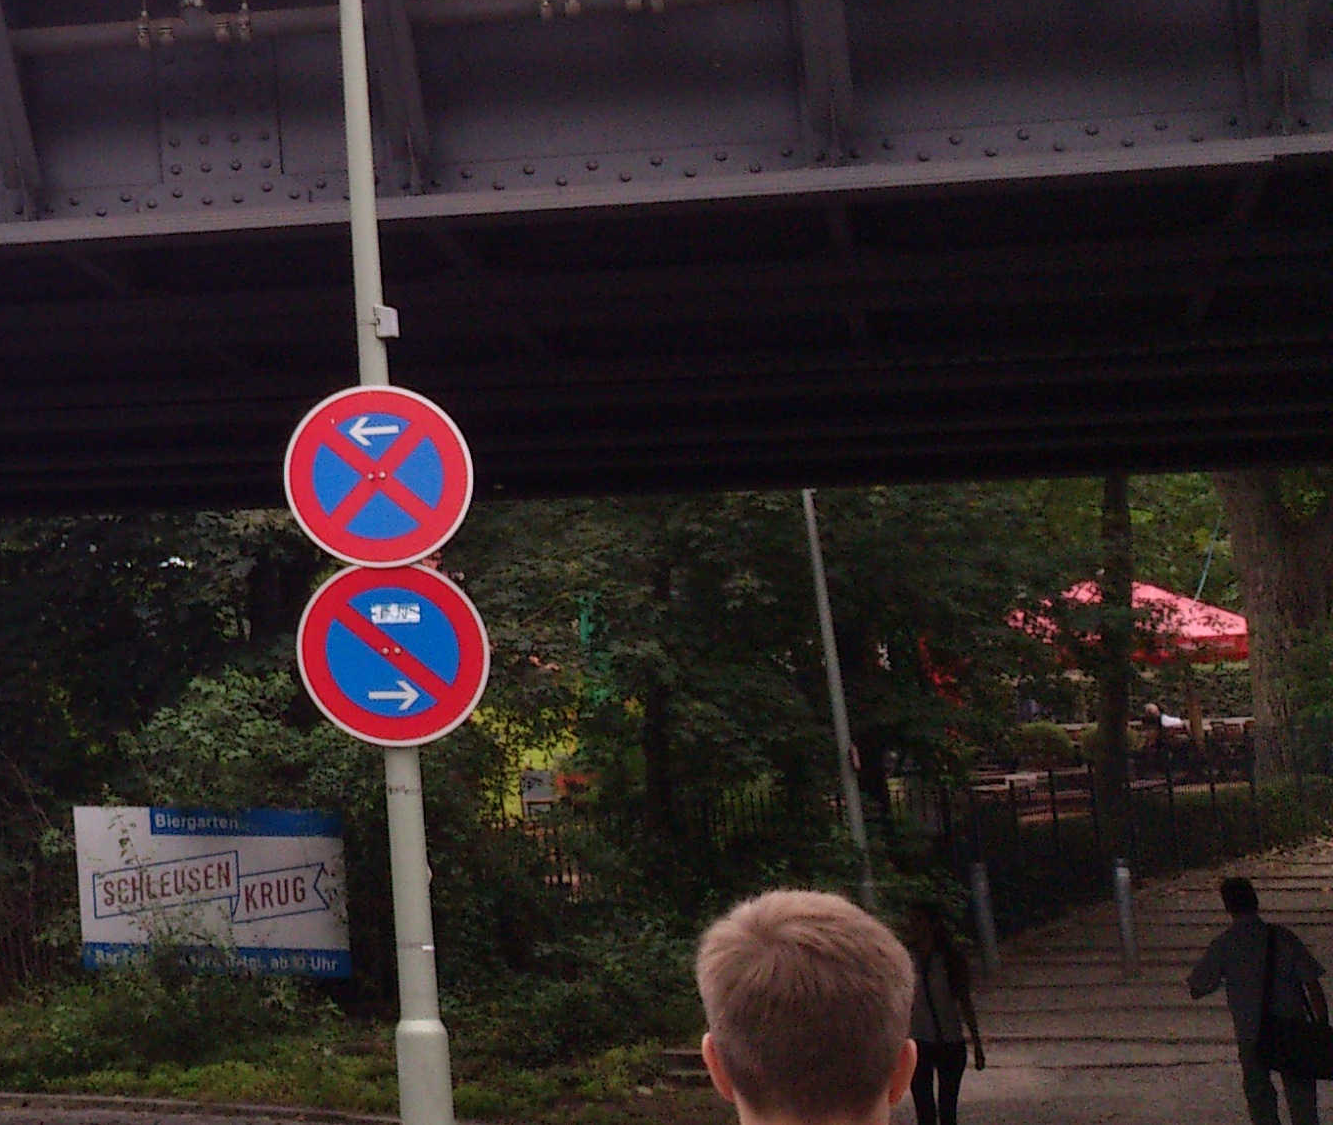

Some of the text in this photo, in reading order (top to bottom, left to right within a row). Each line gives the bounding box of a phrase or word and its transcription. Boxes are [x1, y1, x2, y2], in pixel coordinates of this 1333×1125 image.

[153, 813, 240, 830] Biergarten
[102, 860, 306, 913] SCHLEUSEN KRUG
[310, 955, 337, 971] Uhr
